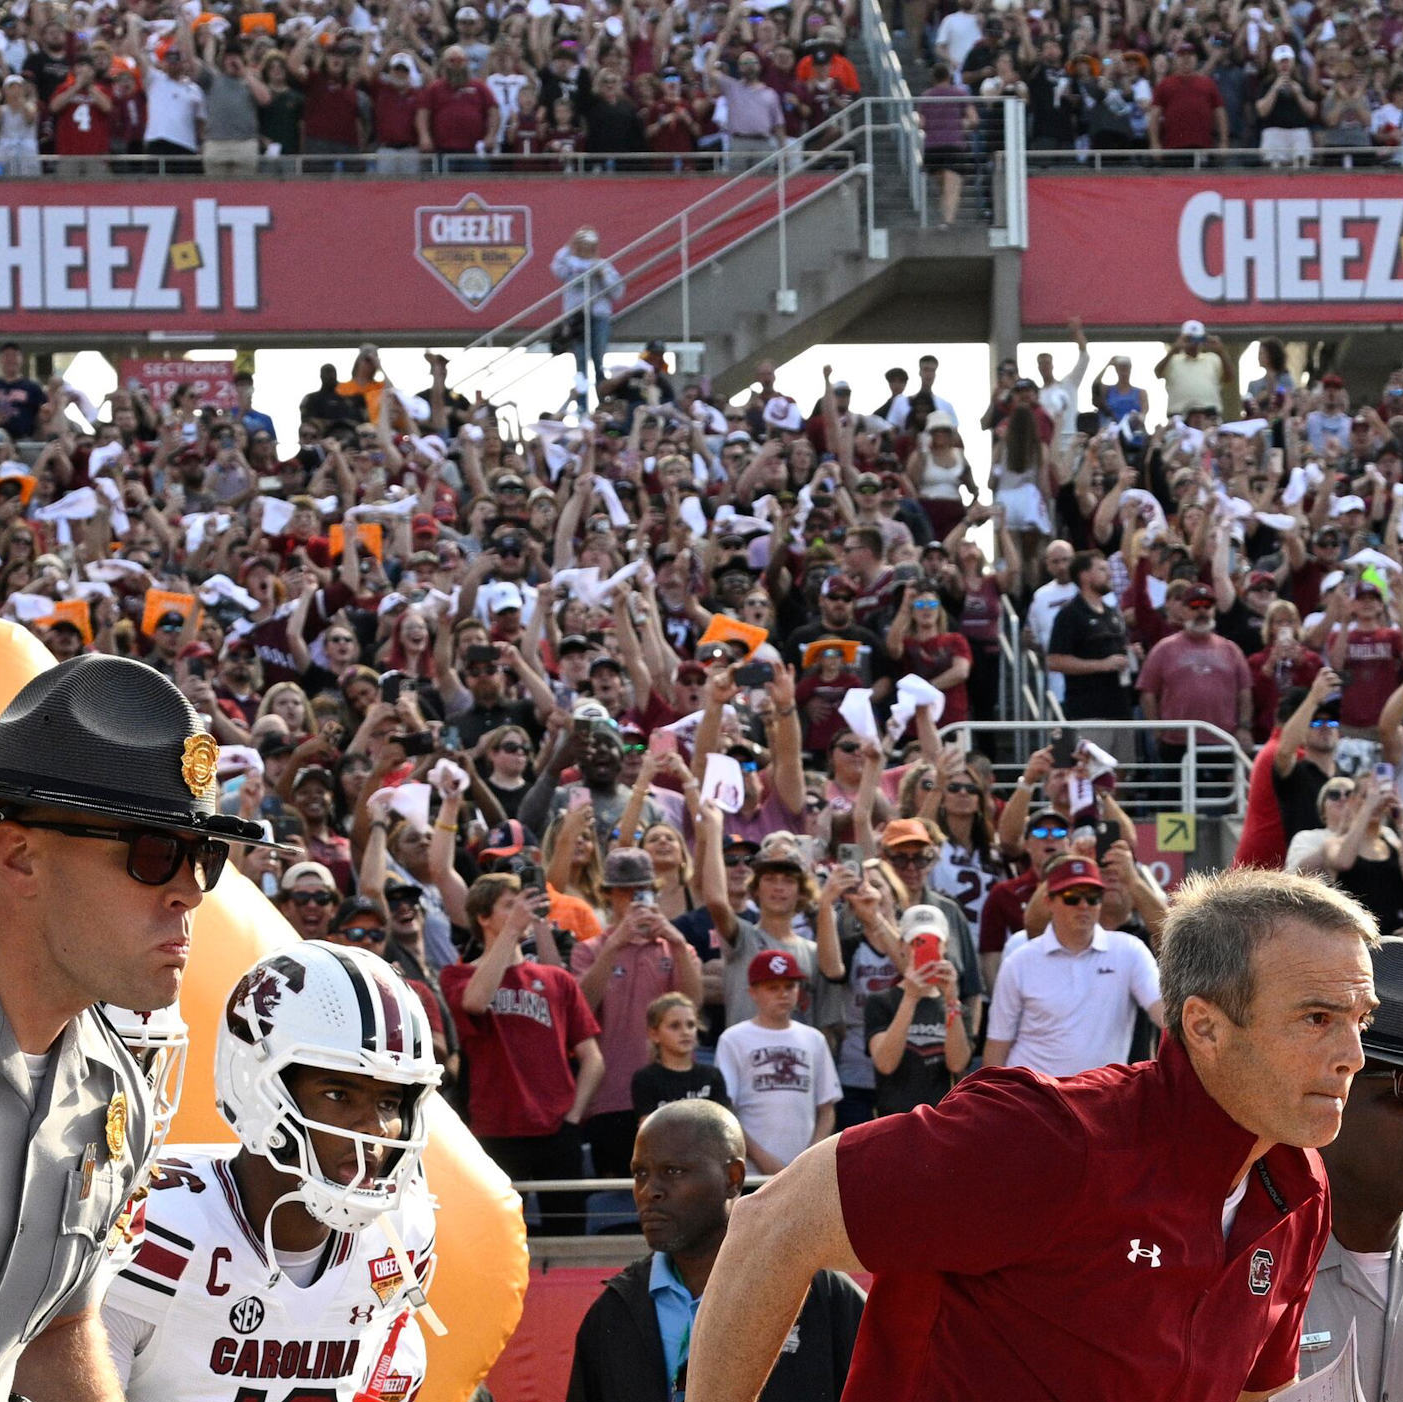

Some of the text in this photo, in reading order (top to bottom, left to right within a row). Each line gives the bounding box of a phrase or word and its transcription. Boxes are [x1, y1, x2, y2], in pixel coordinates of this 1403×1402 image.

[72, 103, 92, 132] 4
[142, 362, 228, 377] SECTIONS
[206, 1246, 233, 1296] C
[232, 1298, 263, 1334] SEC
[209, 1336, 360, 1380] CAROLINA
